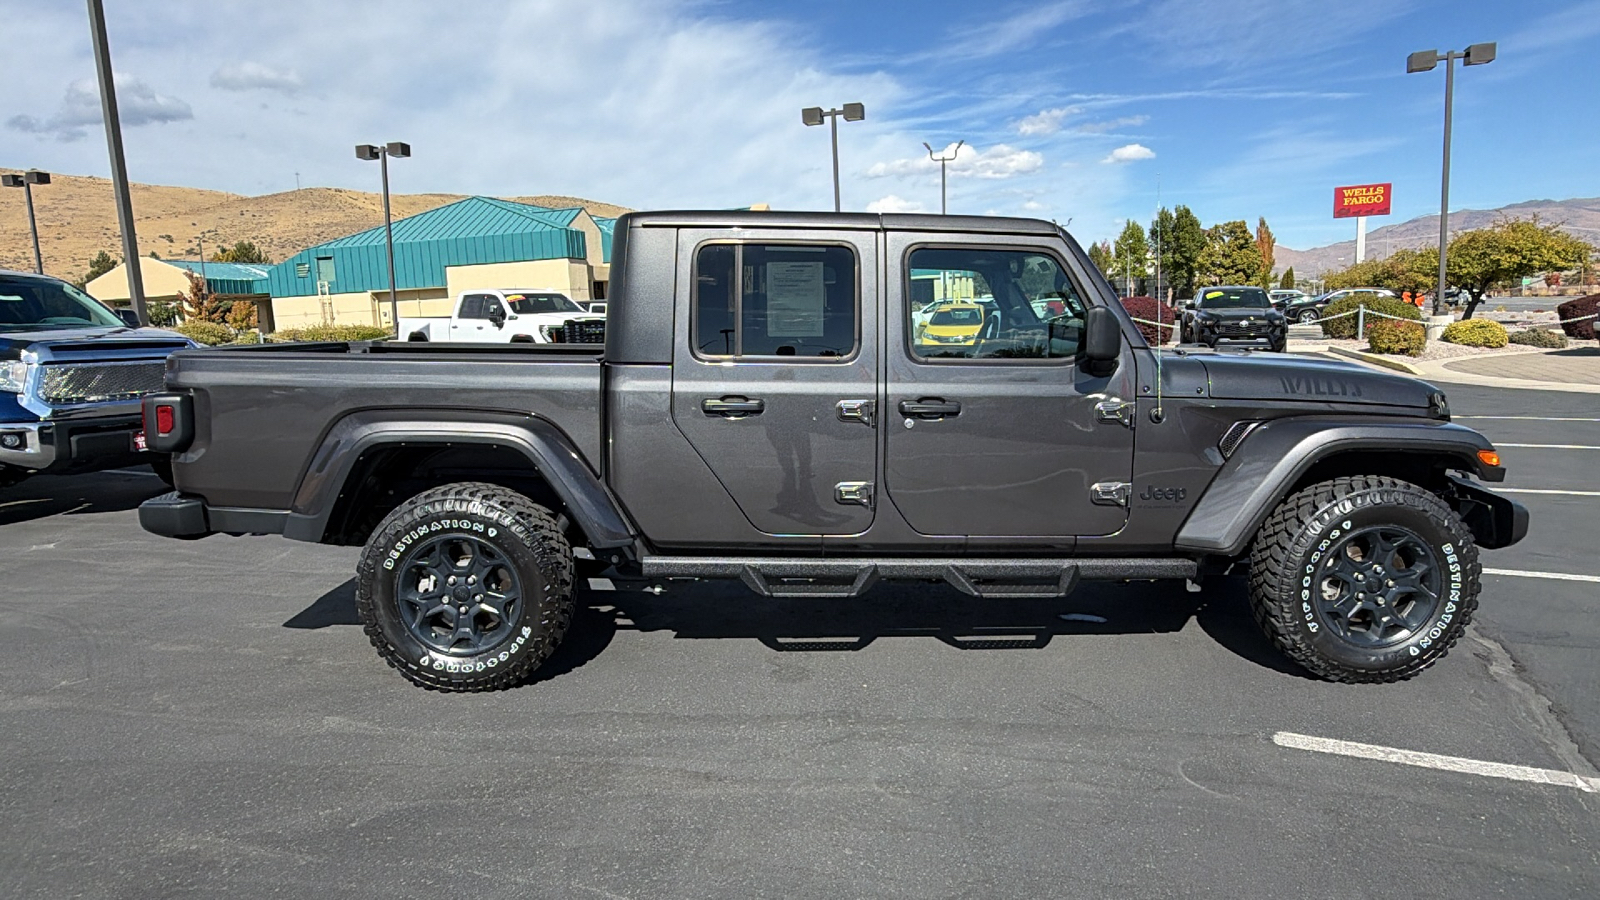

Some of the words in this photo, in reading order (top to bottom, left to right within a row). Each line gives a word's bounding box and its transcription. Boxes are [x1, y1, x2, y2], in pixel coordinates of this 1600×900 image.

[1342, 186, 1384, 197] WELLS
[1343, 195, 1384, 205] FARGO
[1140, 485, 1186, 503] Jeep
[383, 519, 484, 569] DESTINATION
[1420, 543, 1462, 649] DESTINATION
